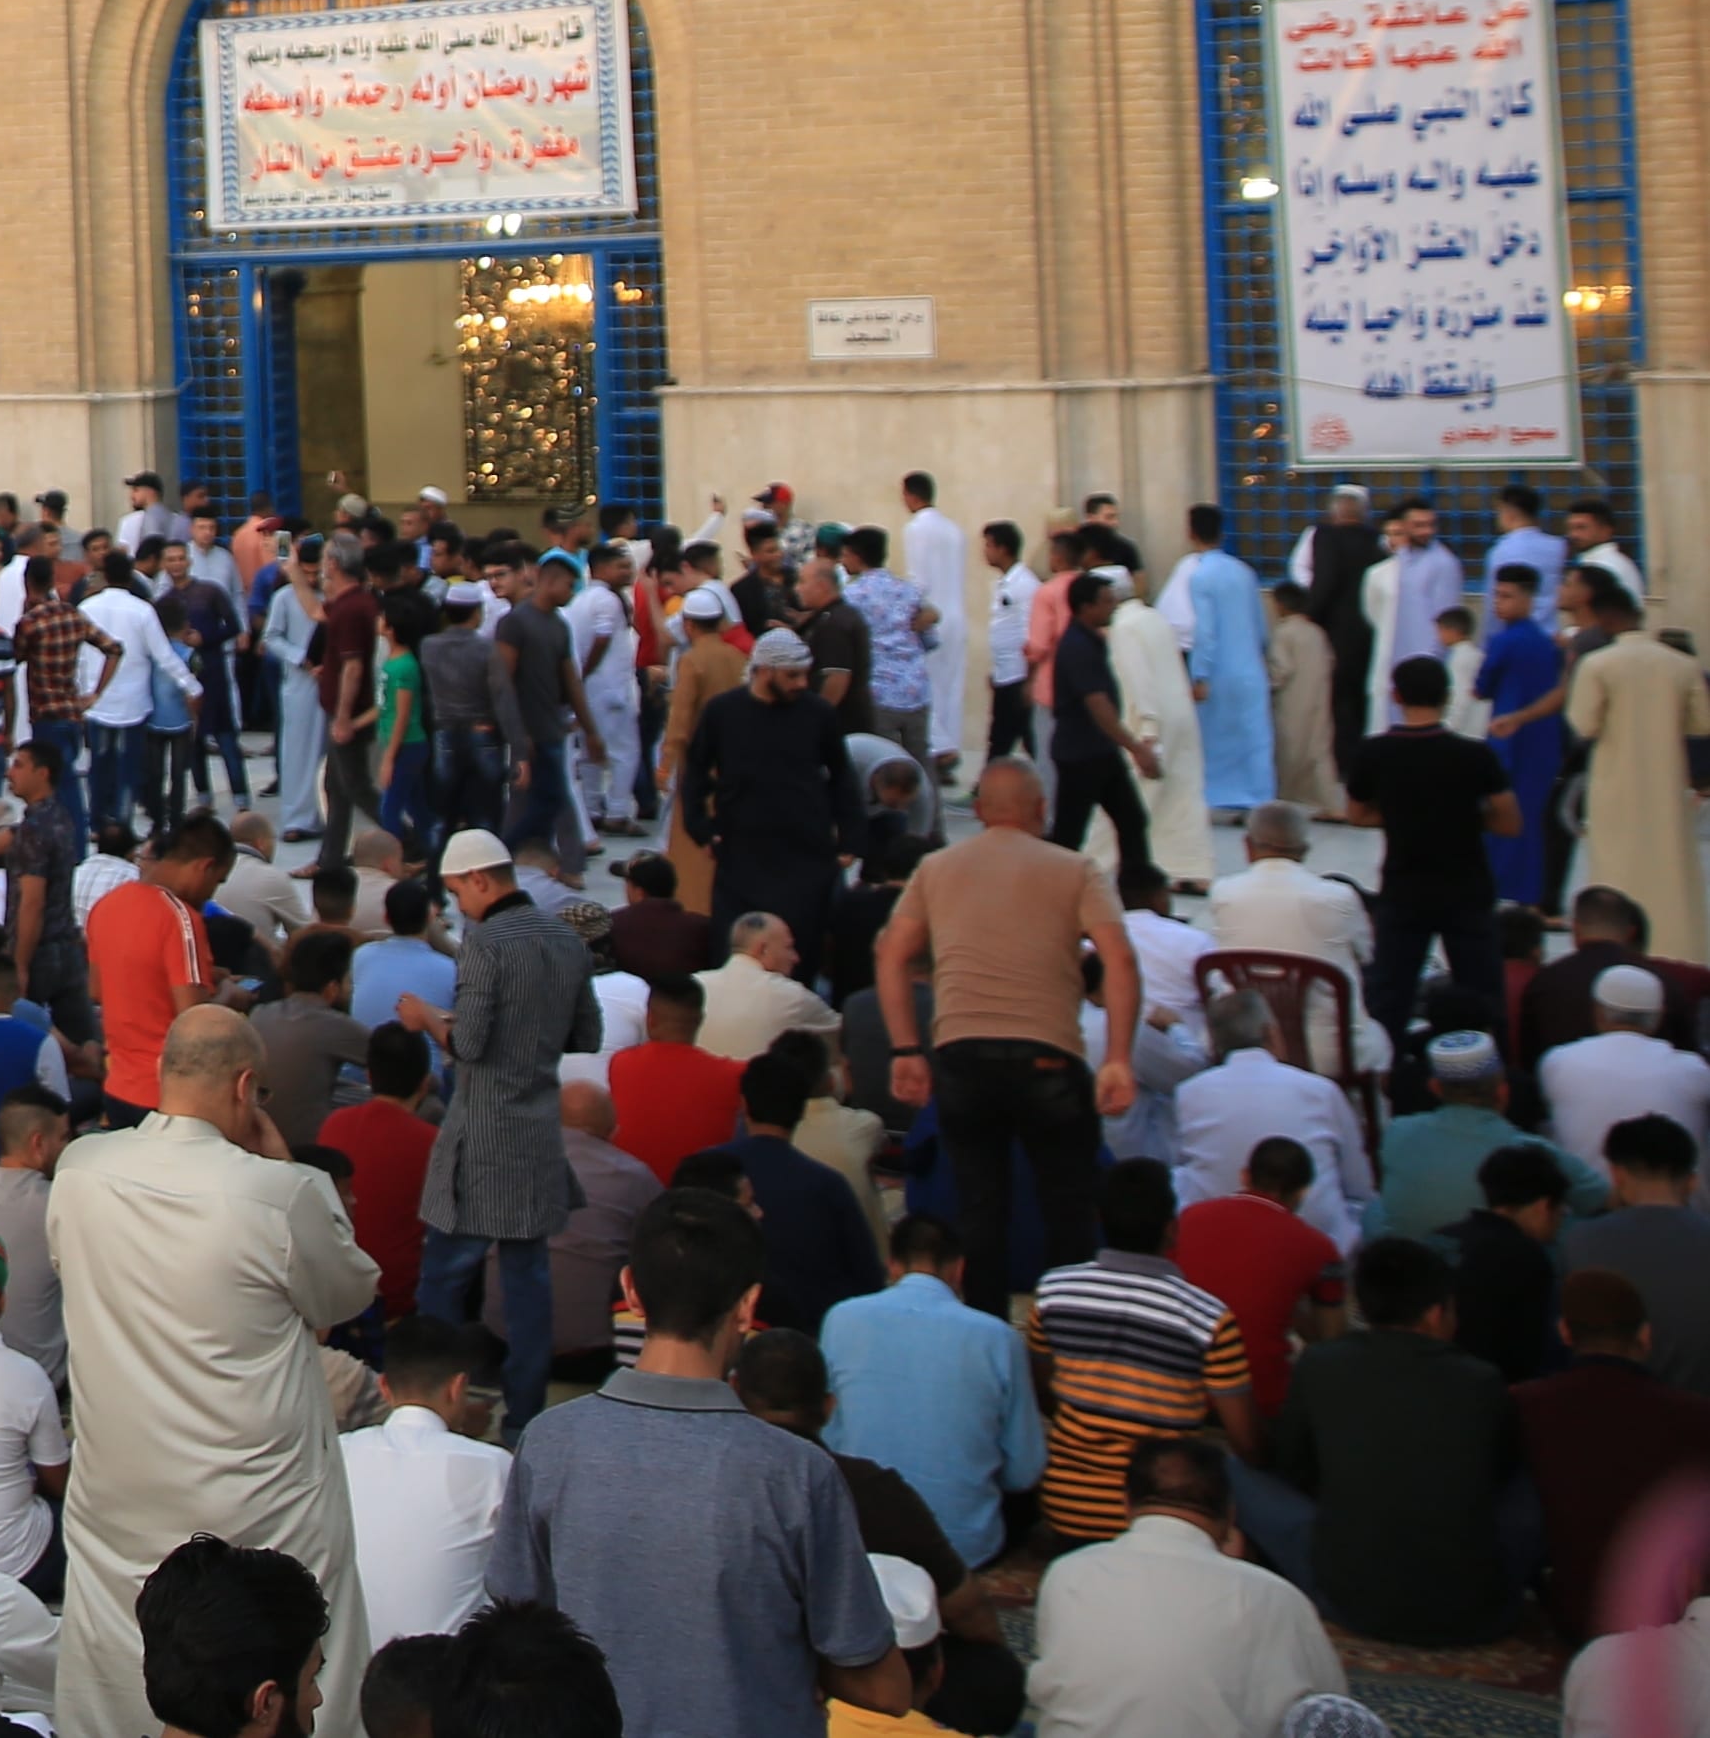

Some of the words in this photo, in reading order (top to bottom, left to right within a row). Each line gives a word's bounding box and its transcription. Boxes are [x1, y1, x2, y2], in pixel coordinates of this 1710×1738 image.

[415, 26, 439, 51] الله
[480, 21, 505, 46] الله
[509, 22, 550, 52] رسول
[464, 67, 539, 109] رمضان
[544, 55, 591, 103] شهر
[1293, 91, 1330, 129] الله
[1411, 86, 1480, 144] النبي
[1488, 79, 1535, 130] كان
[249, 142, 306, 182] النار
[310, 143, 338, 179] من
[344, 137, 404, 178] عتق
[1333, 164, 1398, 208] وسلم
[1476, 156, 1541, 202] عليه
